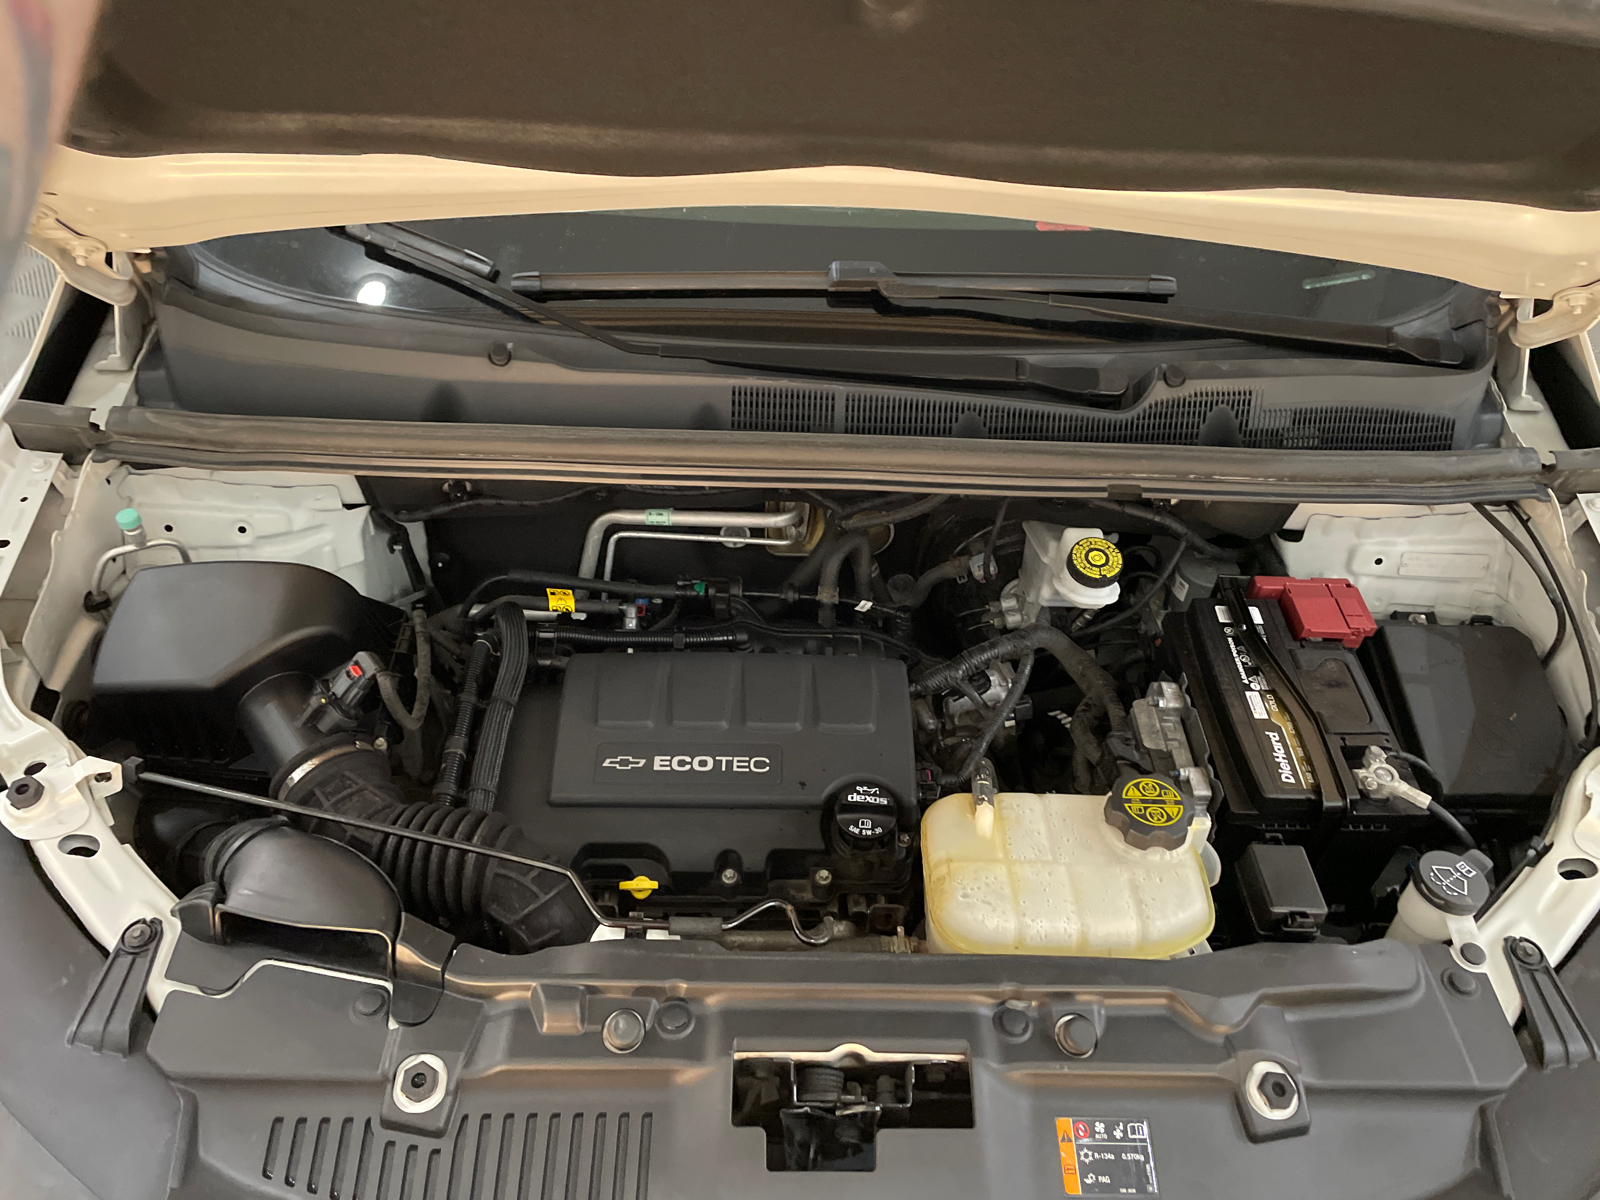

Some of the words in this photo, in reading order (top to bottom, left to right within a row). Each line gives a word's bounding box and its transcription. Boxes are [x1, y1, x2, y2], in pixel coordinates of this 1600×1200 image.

[1266, 694, 1278, 712] GOLD
[1264, 730, 1296, 784] DieHard
[652, 755, 771, 773] ECOTEC
[847, 792, 888, 805] dexos
[848, 825, 861, 835] SAE
[861, 826, 883, 836] 5W-30
[1094, 1152, 1116, 1160] R-134a
[1098, 1175, 1111, 1184] PAG
